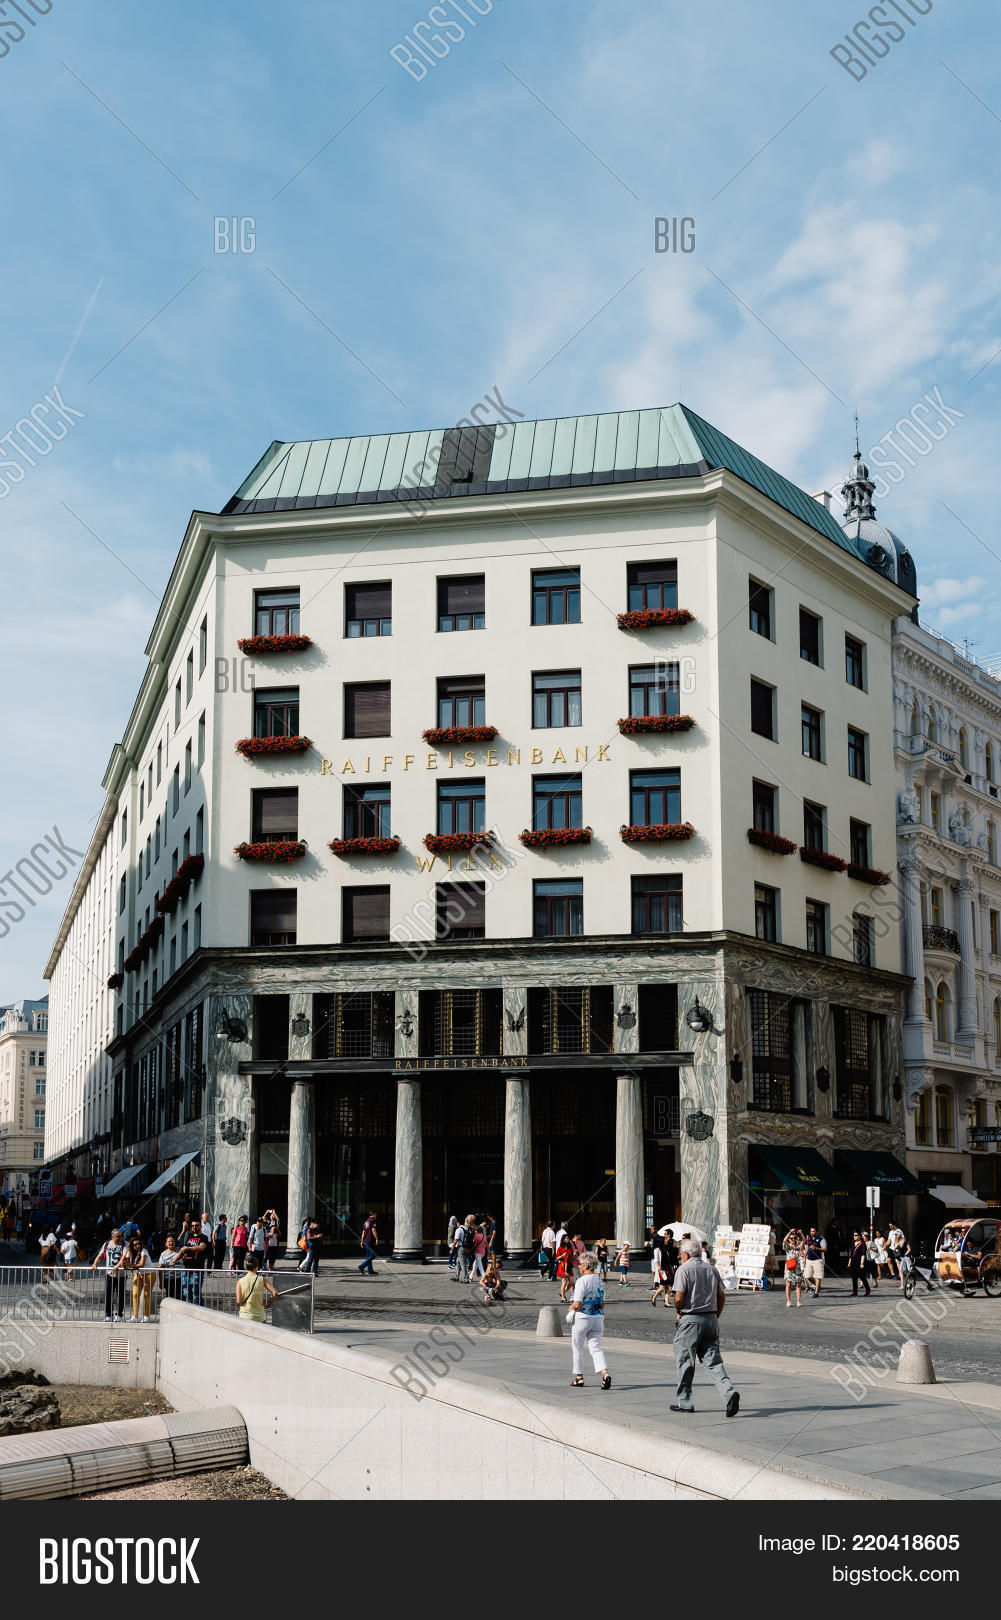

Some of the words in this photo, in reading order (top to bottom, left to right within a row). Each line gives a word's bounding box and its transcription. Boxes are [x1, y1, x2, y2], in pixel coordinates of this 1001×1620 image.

[320, 744, 611, 775] RAIFFEISENBANK
[416, 854, 504, 872] WIEN
[395, 1057, 528, 1069] RAIFFEISENBANK
